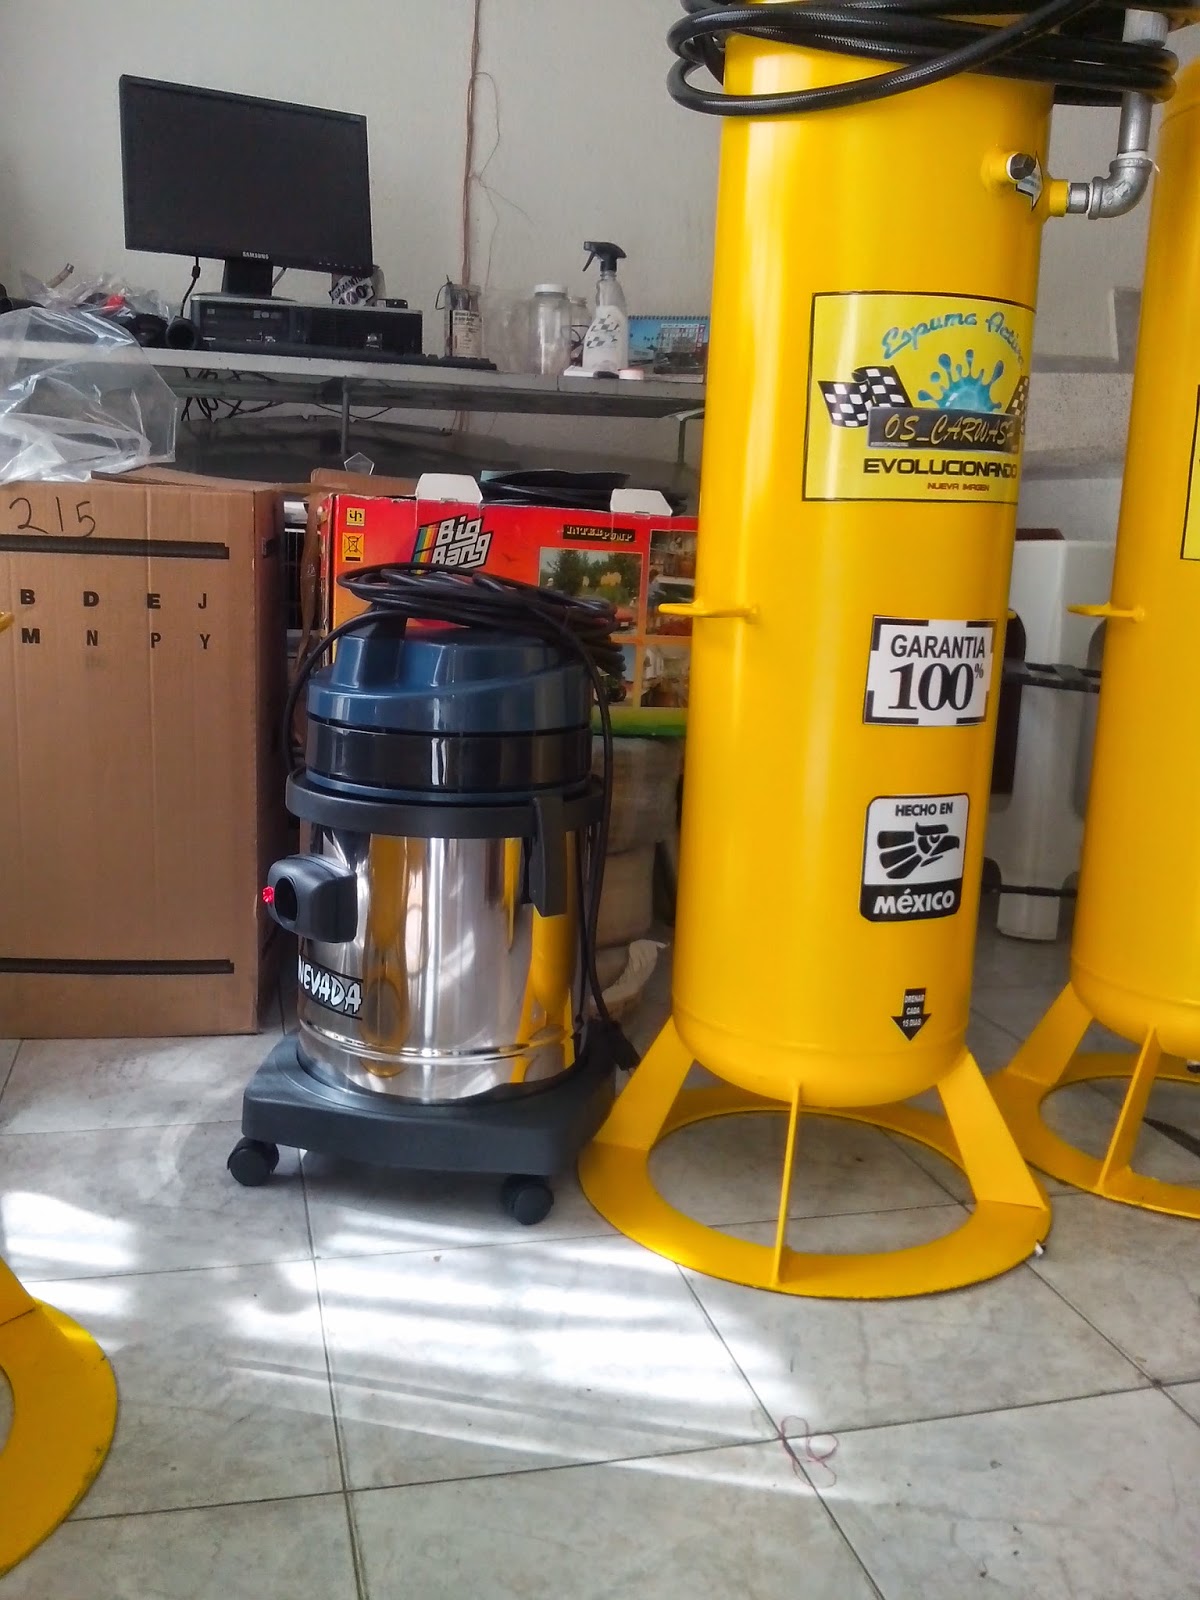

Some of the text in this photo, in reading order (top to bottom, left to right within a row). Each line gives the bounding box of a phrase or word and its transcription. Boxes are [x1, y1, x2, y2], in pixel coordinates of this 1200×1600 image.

[242, 251, 269, 260] SAMSUNG
[881, 312, 977, 359] Espuma
[863, 458, 1018, 479] EVOLUCIONANDO
[927, 482, 990, 492] NUEVA IMAGEN
[9, 497, 96, 538] 215
[435, 515, 482, 550] Big
[20, 589, 208, 609] B D E J
[22, 628, 212, 649] M N P Y
[890, 634, 986, 659] GARANTIA
[895, 802, 954, 817] HECHO EN
[298, 954, 363, 1013] NEVADA
